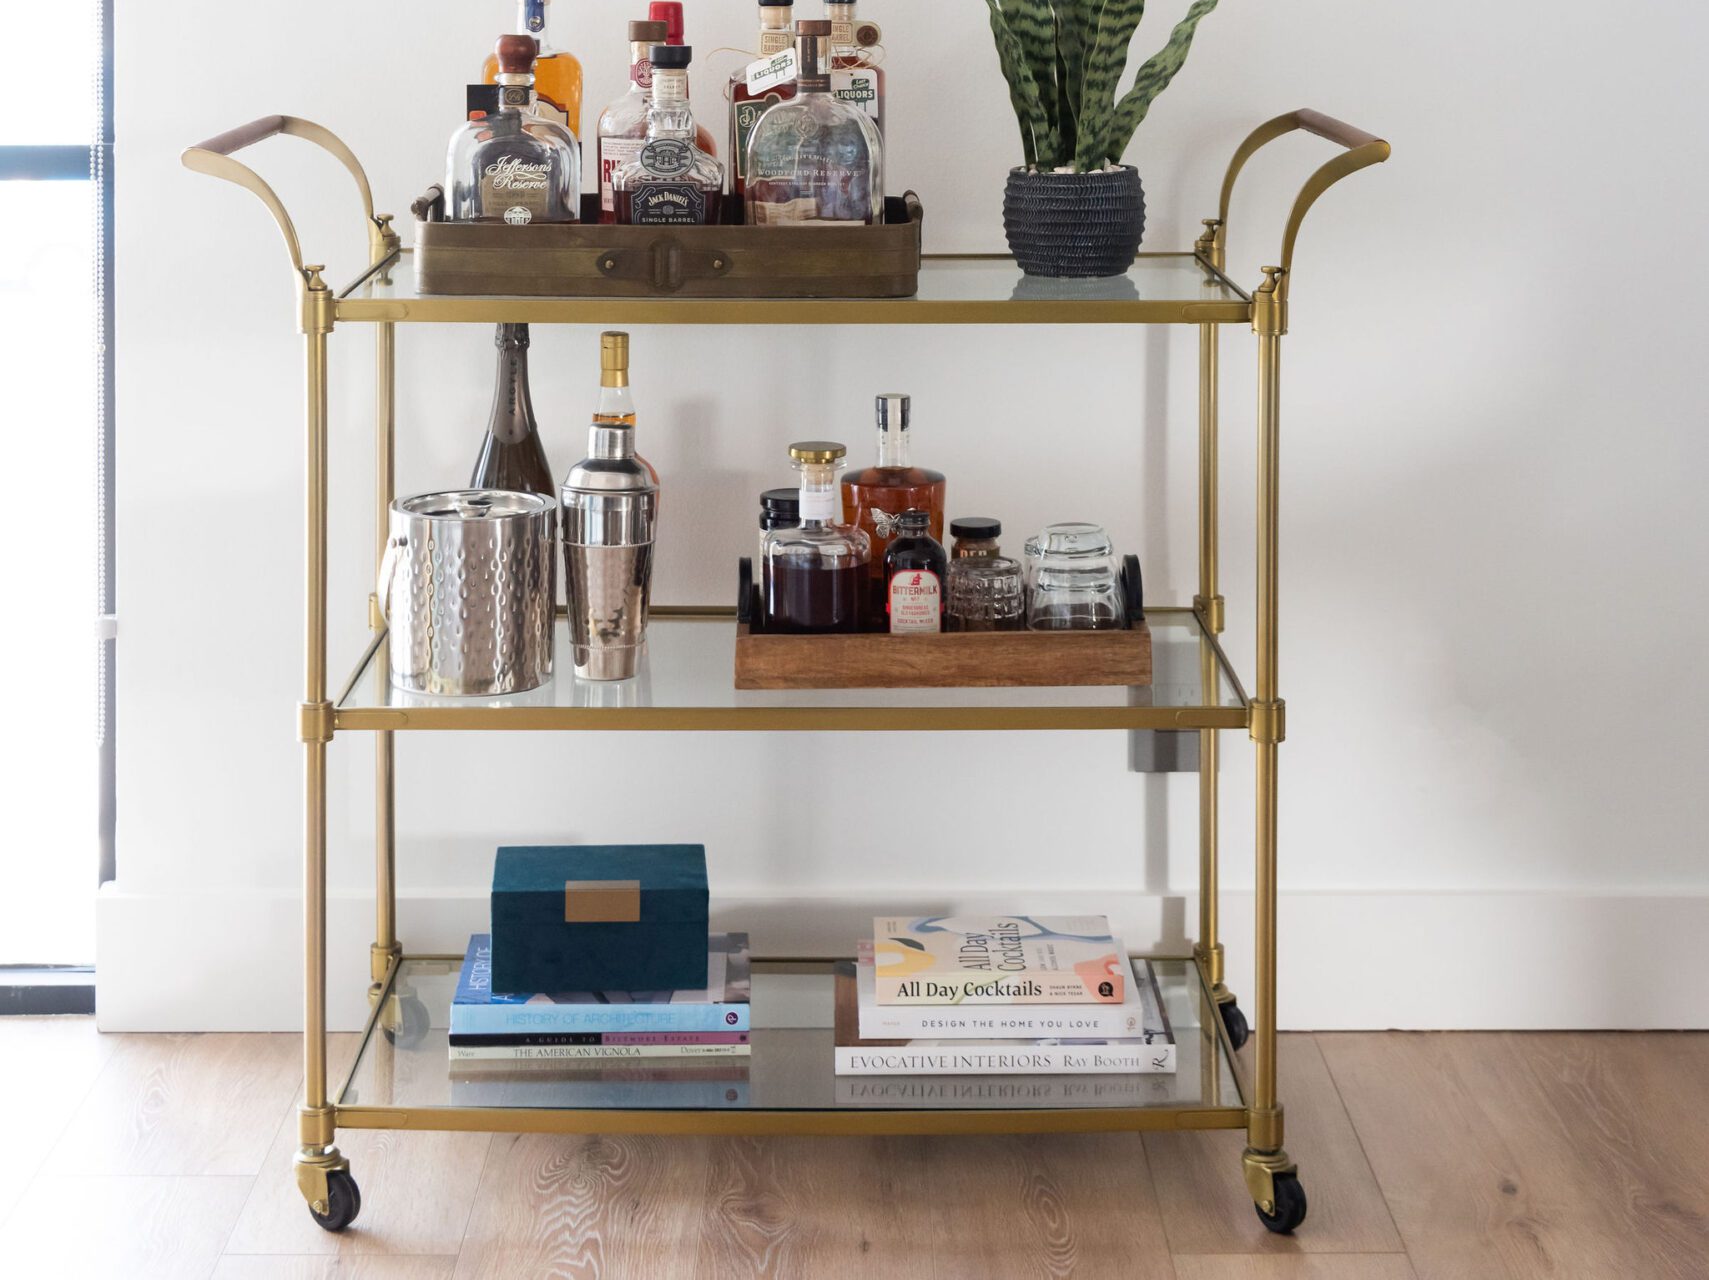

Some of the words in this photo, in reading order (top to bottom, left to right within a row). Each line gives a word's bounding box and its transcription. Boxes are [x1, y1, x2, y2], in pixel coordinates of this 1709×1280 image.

[836, 90, 874, 99] LIQUORS
[485, 155, 552, 176] Jefferson's
[757, 168, 810, 177] WOODFORD
[812, 168, 860, 177] RESERVE
[493, 173, 547, 190] Reserve
[648, 194, 663, 207] JACK
[508, 359, 517, 416] ARGYLE
[892, 585, 938, 596] BITTERMILK
[960, 932, 996, 954] Day
[988, 921, 1027, 972] Cocktails
[958, 956, 993, 971] All
[469, 959, 490, 991] HISTORY
[897, 981, 921, 997] All
[926, 982, 958, 1000] Day
[963, 980, 1042, 998] Cocktails
[505, 1012, 559, 1025] HISTORY
[563, 1012, 579, 1025] OF
[583, 1012, 676, 1025] ARCHITECTURE
[921, 1020, 966, 1028] DESIGN
[1001, 1020, 1033, 1028] HOME
[1039, 1020, 1063, 1028] YOU
[1069, 1020, 1100, 1028] LOVE
[514, 1048, 533, 1058] THE
[535, 1048, 591, 1058] AMERICAN
[594, 1047, 642, 1057] VIGNOLA
[680, 1046, 704, 1054] Dover
[851, 1055, 949, 1069] EVOCATIVE
[953, 1055, 1052, 1068] INTERIORS
[1063, 1054, 1088, 1067] RAY
[1093, 1054, 1140, 1067] BOOTH
